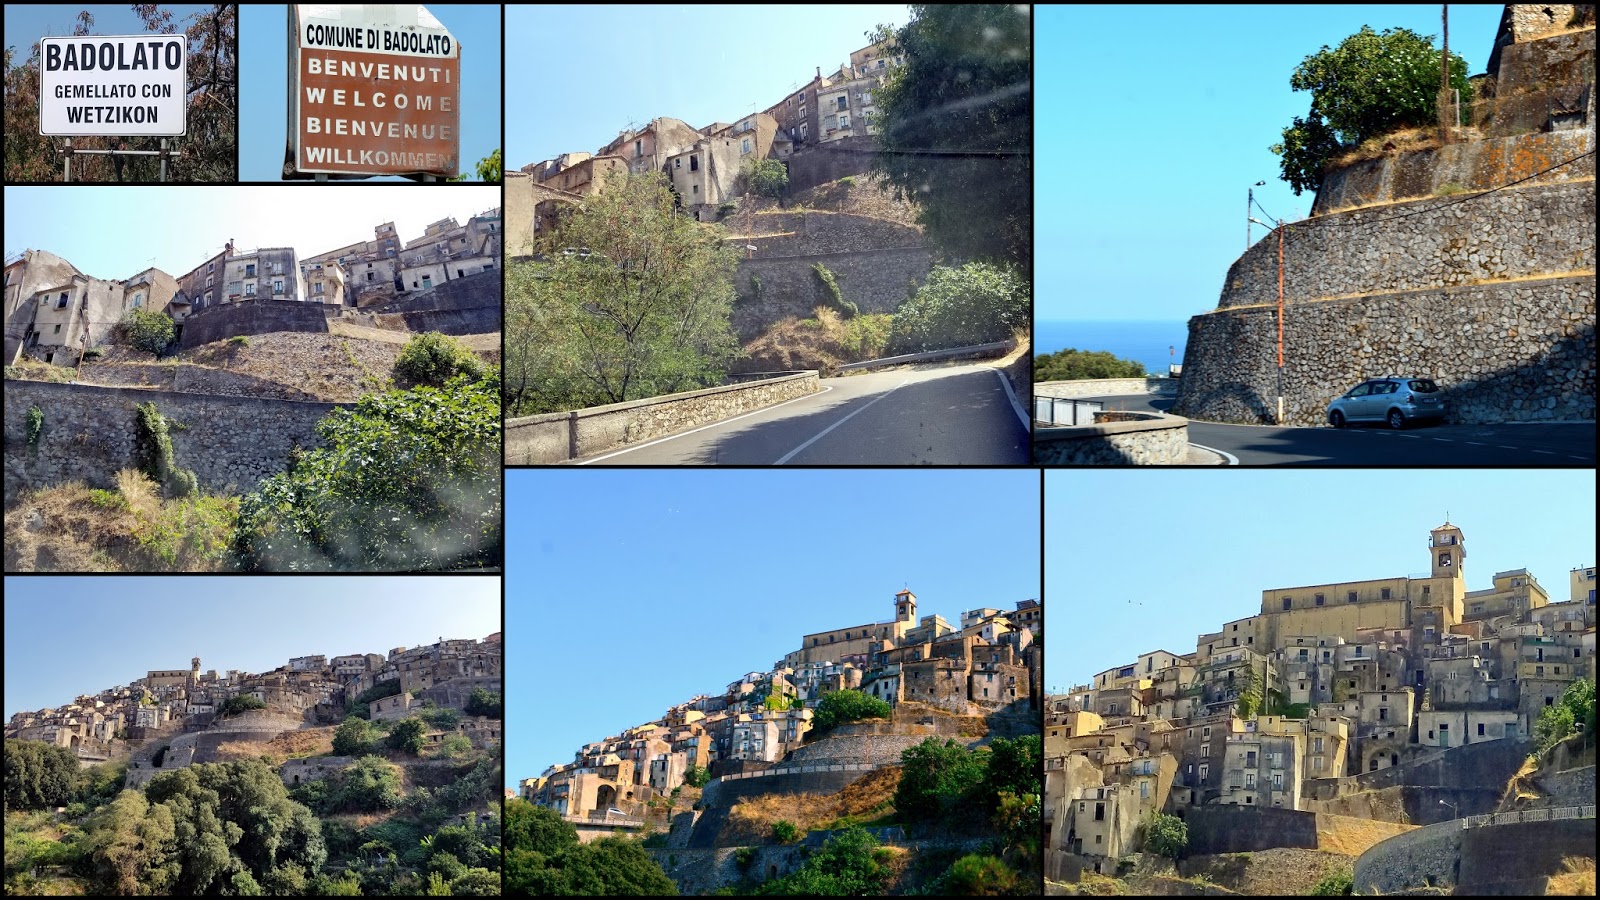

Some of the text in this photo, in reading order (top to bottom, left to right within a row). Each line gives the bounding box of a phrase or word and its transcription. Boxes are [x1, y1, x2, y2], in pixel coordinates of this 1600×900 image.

[306, 24, 451, 56] COMUNE DI BADOLATO
[46, 41, 181, 72] BADOLATO
[308, 58, 450, 84] BENVENUTI
[54, 84, 171, 99] GEMELLATO CON
[306, 87, 452, 112] WELCOME
[67, 106, 158, 124] WETZIKON
[306, 117, 451, 140] BIENVENUE
[305, 147, 451, 168] WILLKOMMEN
